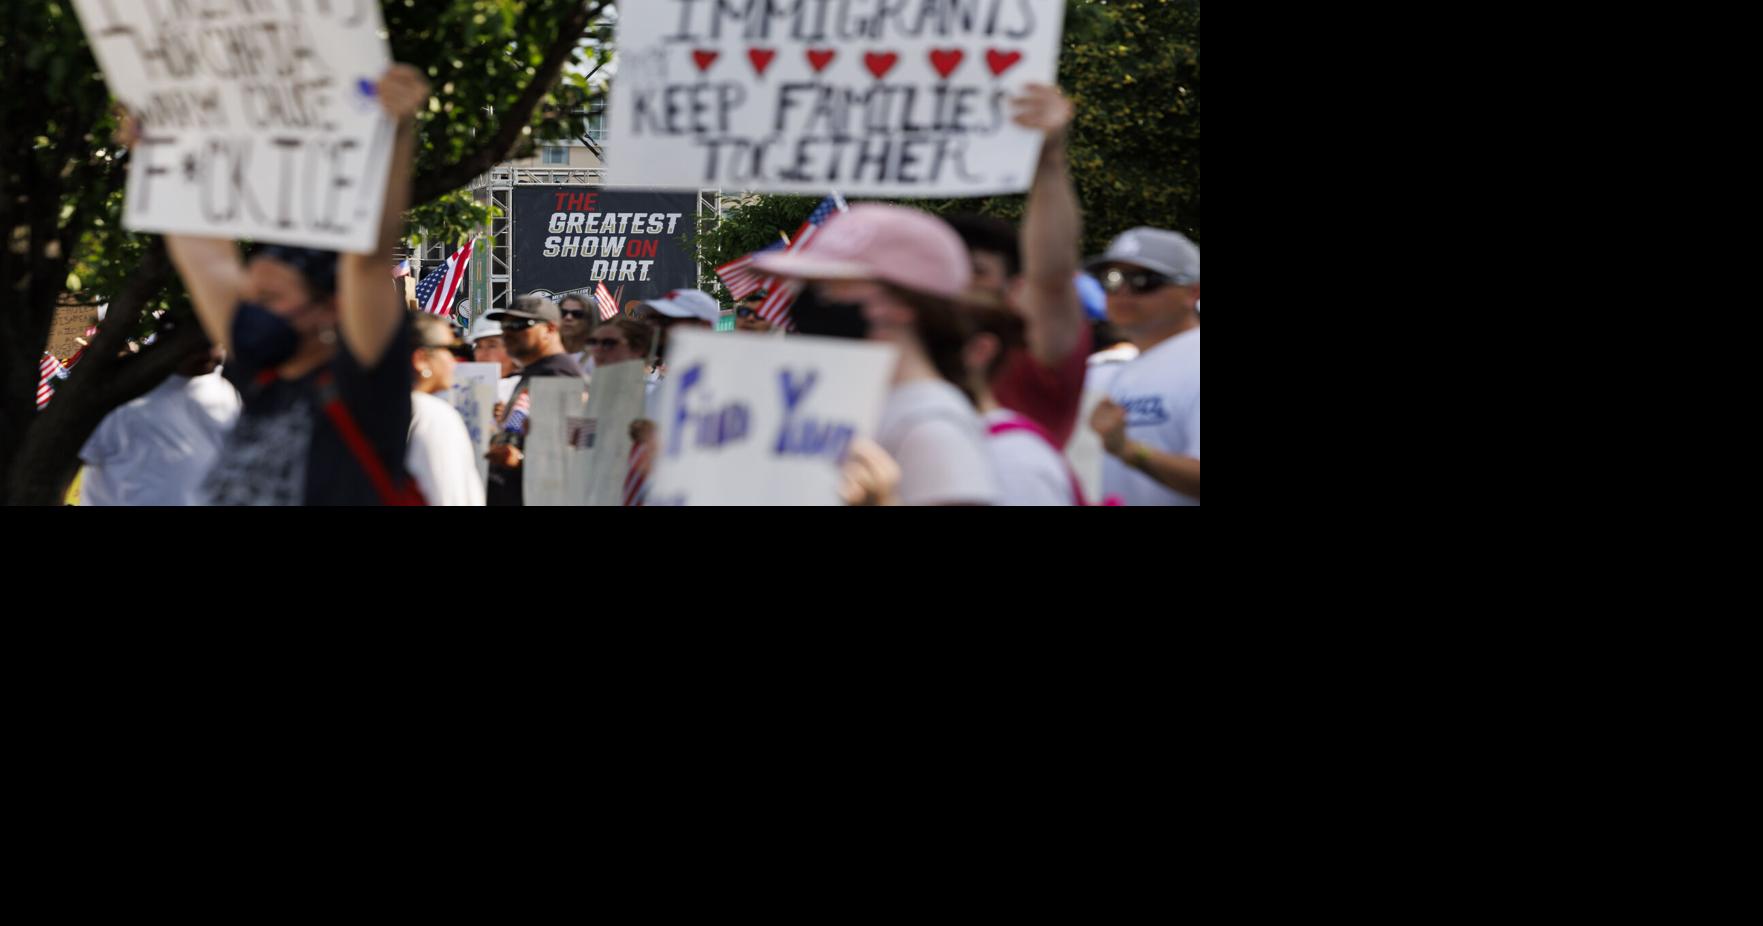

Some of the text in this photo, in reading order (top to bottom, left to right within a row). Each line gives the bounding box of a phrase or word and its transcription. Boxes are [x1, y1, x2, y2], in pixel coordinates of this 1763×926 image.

[630, 82, 1008, 136] KEEP FAMILIES
[694, 135, 984, 184] TOGETHER
[555, 191, 599, 212] THE
[548, 212, 682, 234] GREATEST
[543, 236, 659, 258] SHOW ON
